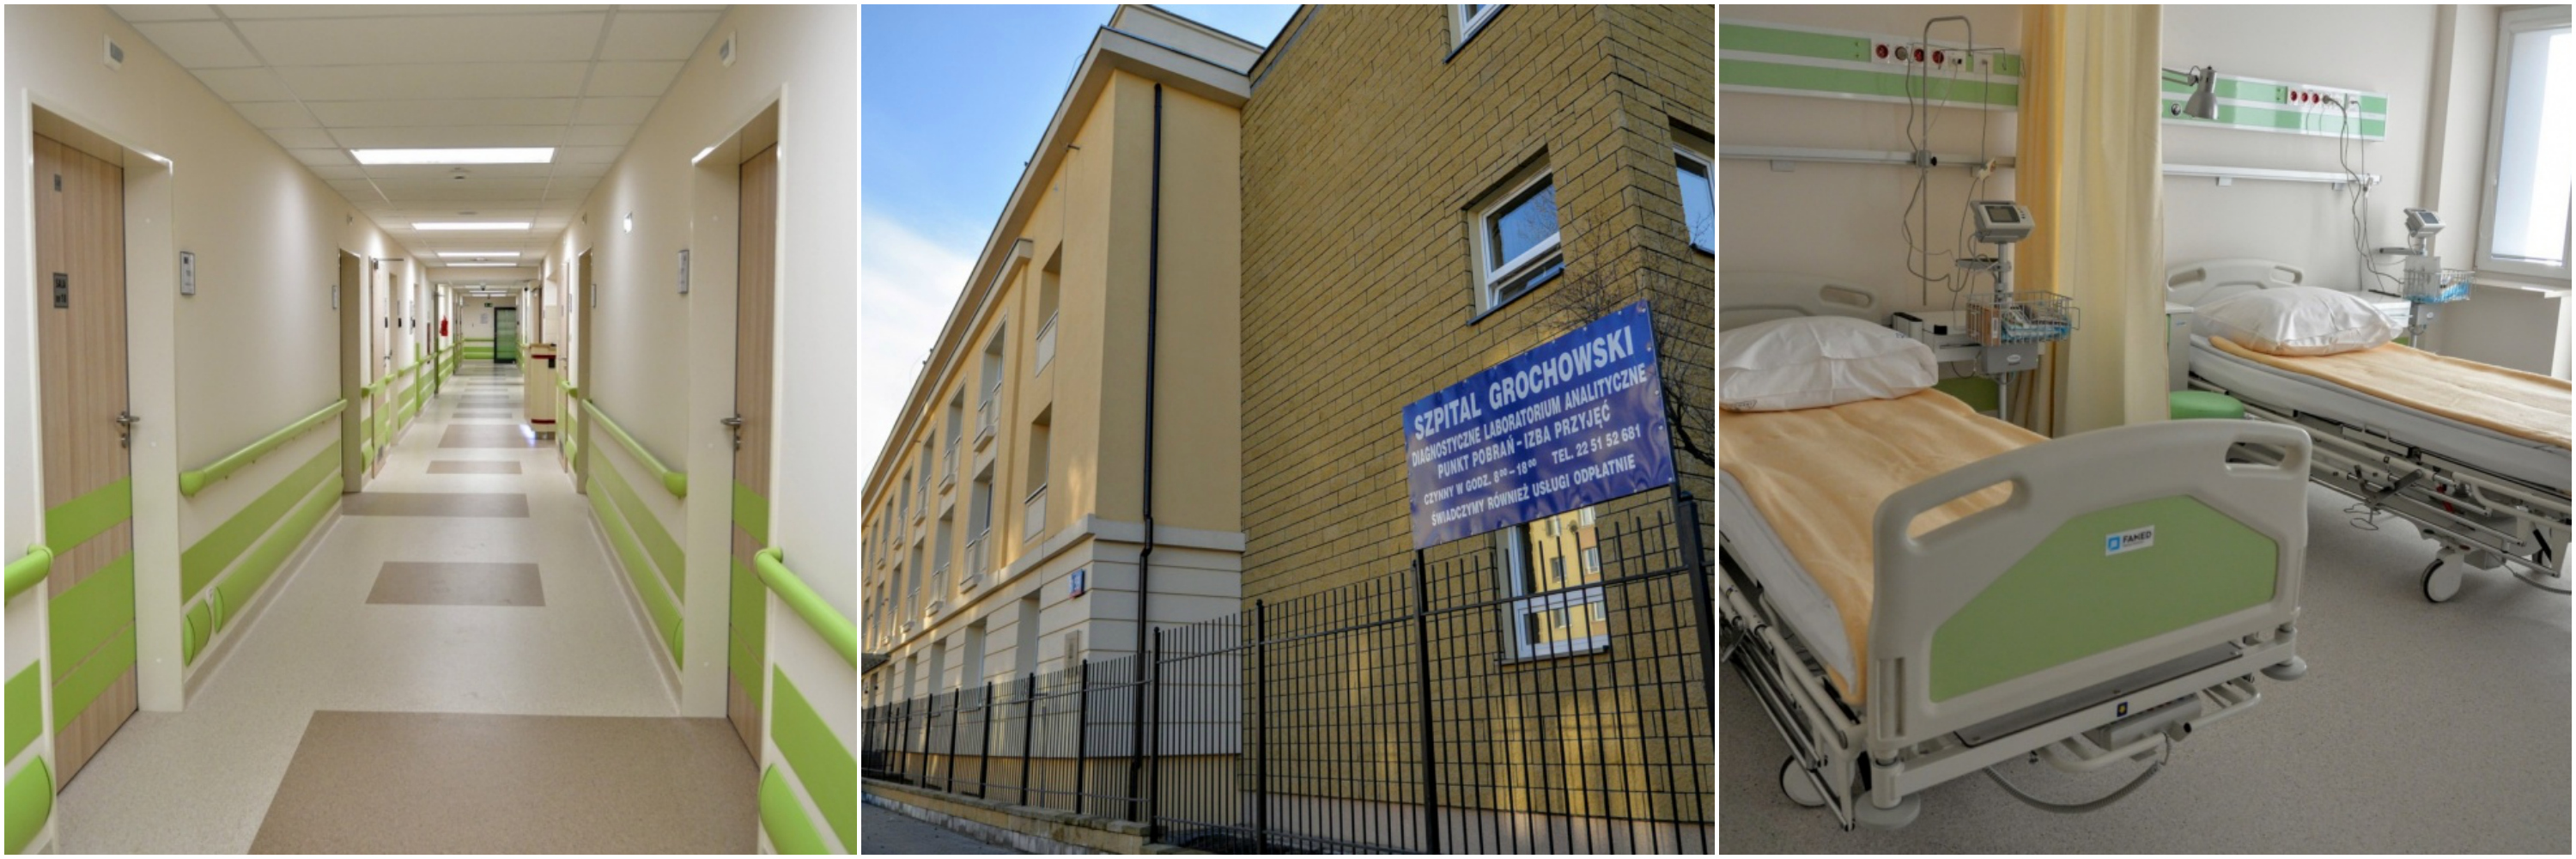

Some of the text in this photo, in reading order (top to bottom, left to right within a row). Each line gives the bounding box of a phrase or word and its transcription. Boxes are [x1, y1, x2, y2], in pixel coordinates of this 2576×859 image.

[1412, 362, 1647, 467] DIAGNOSTYCZNE LABORATORIUM ANALITYCZNE
[1414, 325, 1634, 441] SZPITAL GROCHOWSKI
[1425, 485, 1454, 505] CZYNNY
[1455, 483, 1463, 495] W
[1466, 474, 1492, 492] GODZ.
[1552, 448, 1574, 464] TEL.
[1576, 441, 1589, 457] 22
[1591, 436, 1602, 452] 51
[1606, 431, 1619, 448] 52
[1621, 423, 1641, 442] 681
[1437, 454, 1469, 479] PUNKT
[1472, 435, 1515, 467] POBRAŃ
[1523, 425, 1551, 449] IZBA
[1554, 399, 1610, 439] PRZYJĘĆ
[1431, 454, 1636, 527] ŚWIADCZYMY RÓWNIEŻ USŁUGI ODPŁATNIE
